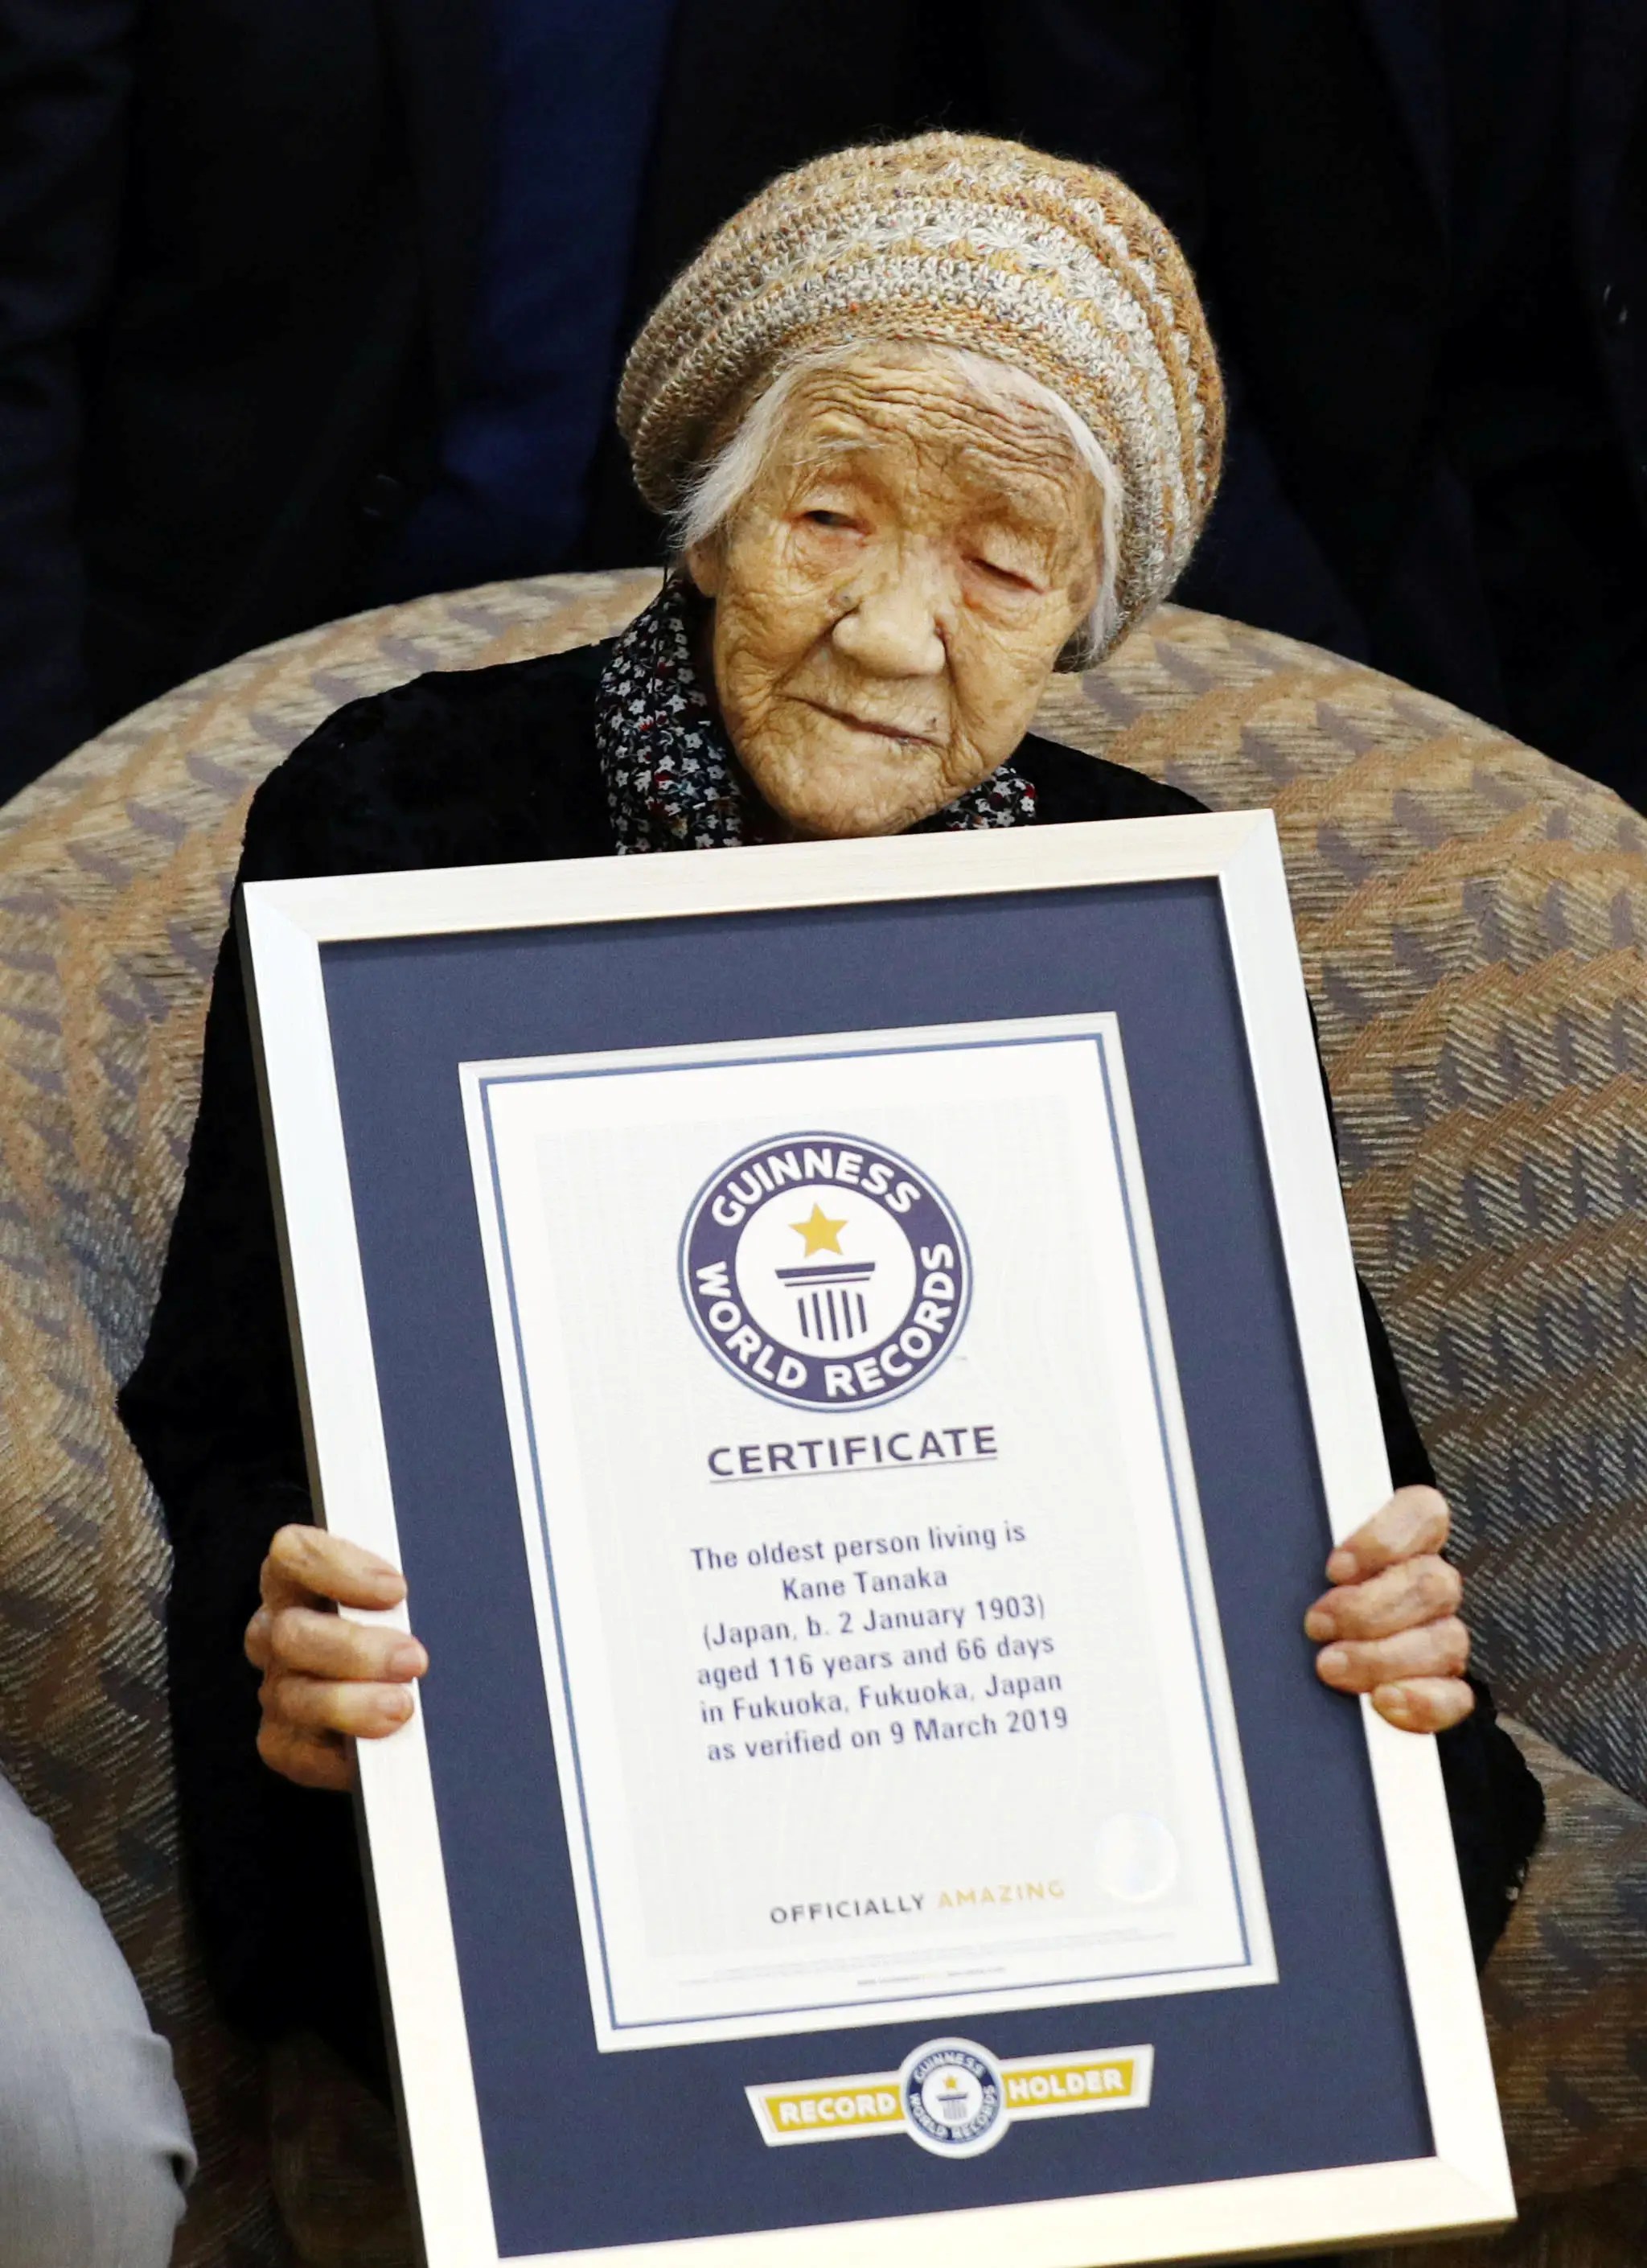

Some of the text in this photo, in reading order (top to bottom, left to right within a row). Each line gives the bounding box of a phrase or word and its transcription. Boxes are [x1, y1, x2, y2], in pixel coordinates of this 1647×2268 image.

[712, 1148, 921, 1226] GUINNESS
[696, 1243, 955, 1398] WORLD RECORDS
[708, 1426, 998, 1477] CERTIFICATE
[690, 1520, 1026, 1571] The oldest person living is
[782, 1566, 947, 1601] Kane Tanaka
[703, 1595, 1045, 1651] (Japan, b. 2 January 1903)
[697, 1635, 1055, 1691] aged 116 years and 66 days
[700, 1674, 1062, 1724] in Fukuoka, Fukuoka, Japan
[708, 1706, 1068, 1761] as verified on 9 March 2019
[770, 1880, 1065, 1925] OFFICIALLY AMAZING
[778, 2067, 1125, 2126] RECORD HOLDER
